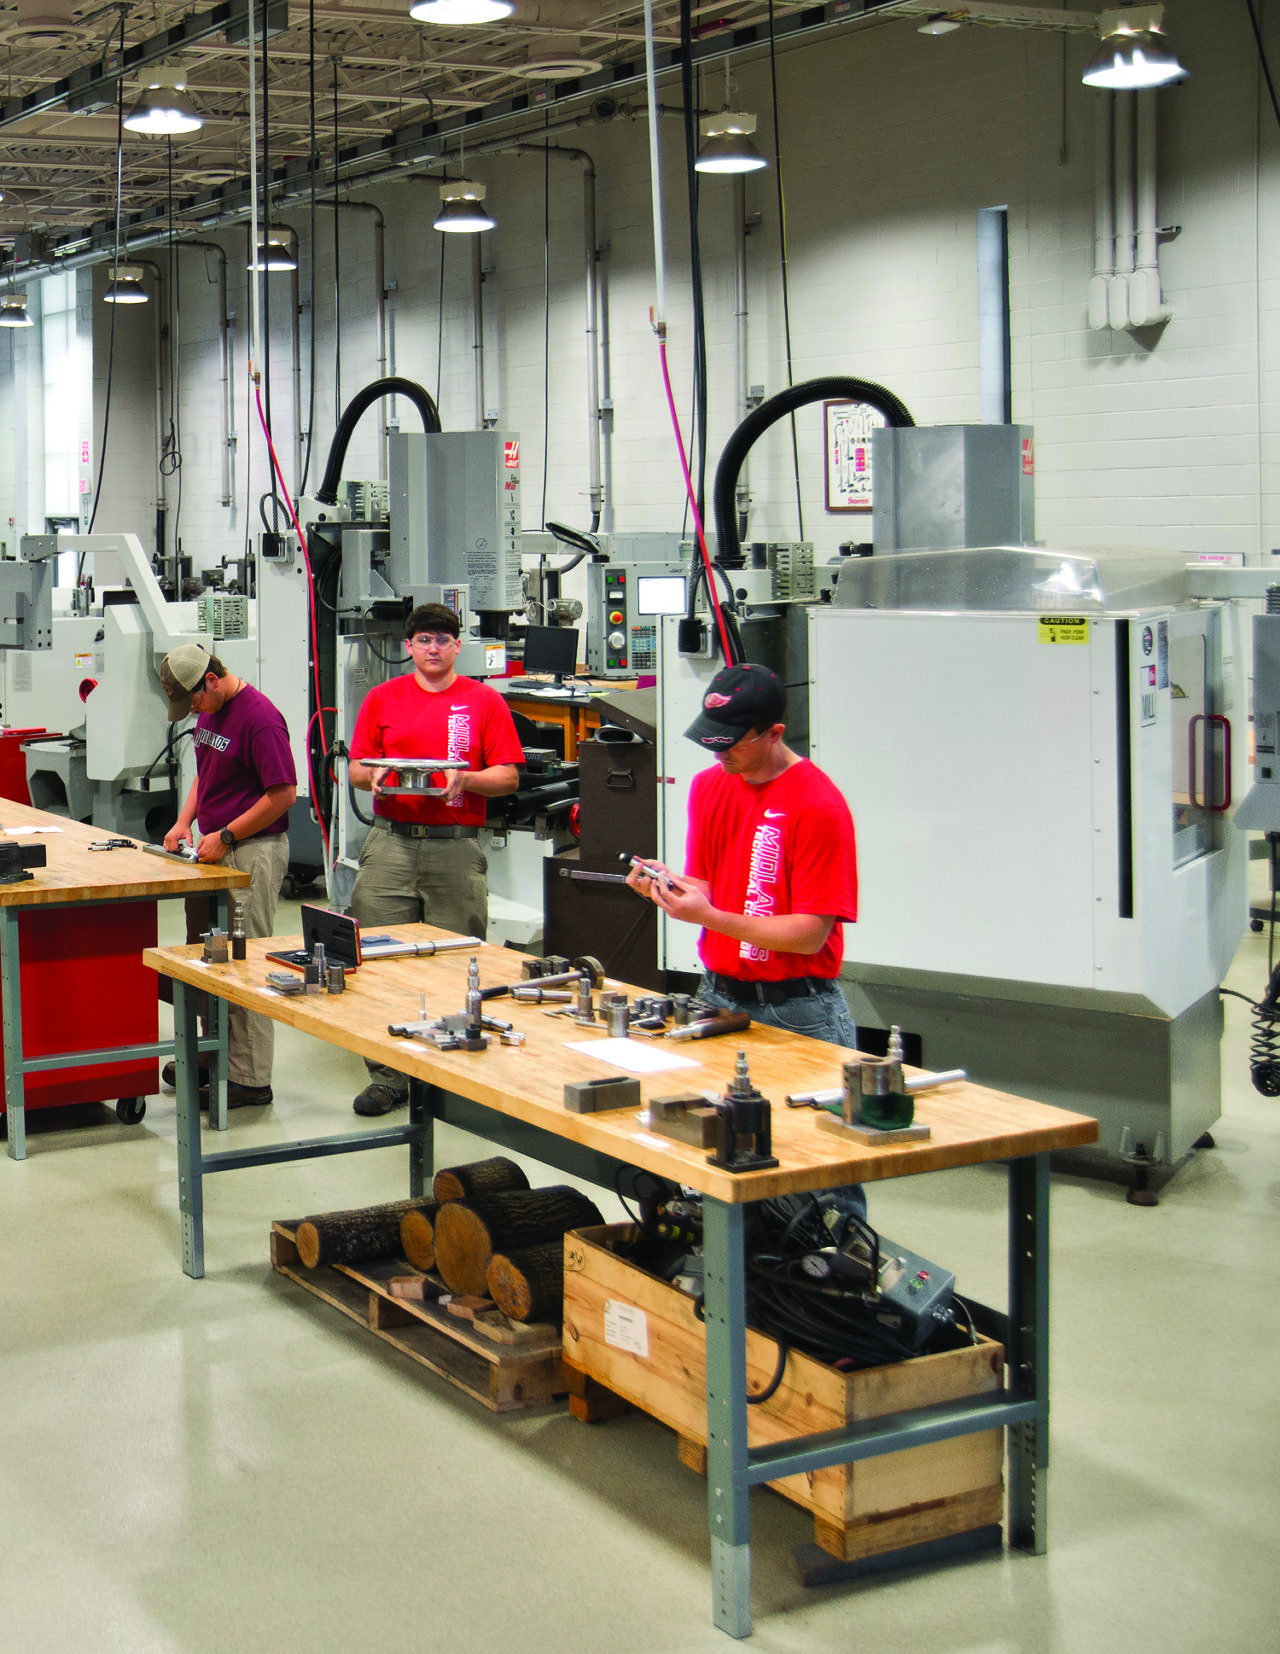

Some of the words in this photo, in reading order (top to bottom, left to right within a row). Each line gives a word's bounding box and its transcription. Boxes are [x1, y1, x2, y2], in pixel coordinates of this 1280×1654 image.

[1043, 616, 1081, 624] CAUTION
[745, 825, 766, 897] TECHNICAL
[749, 824, 781, 962] MIDLAS
